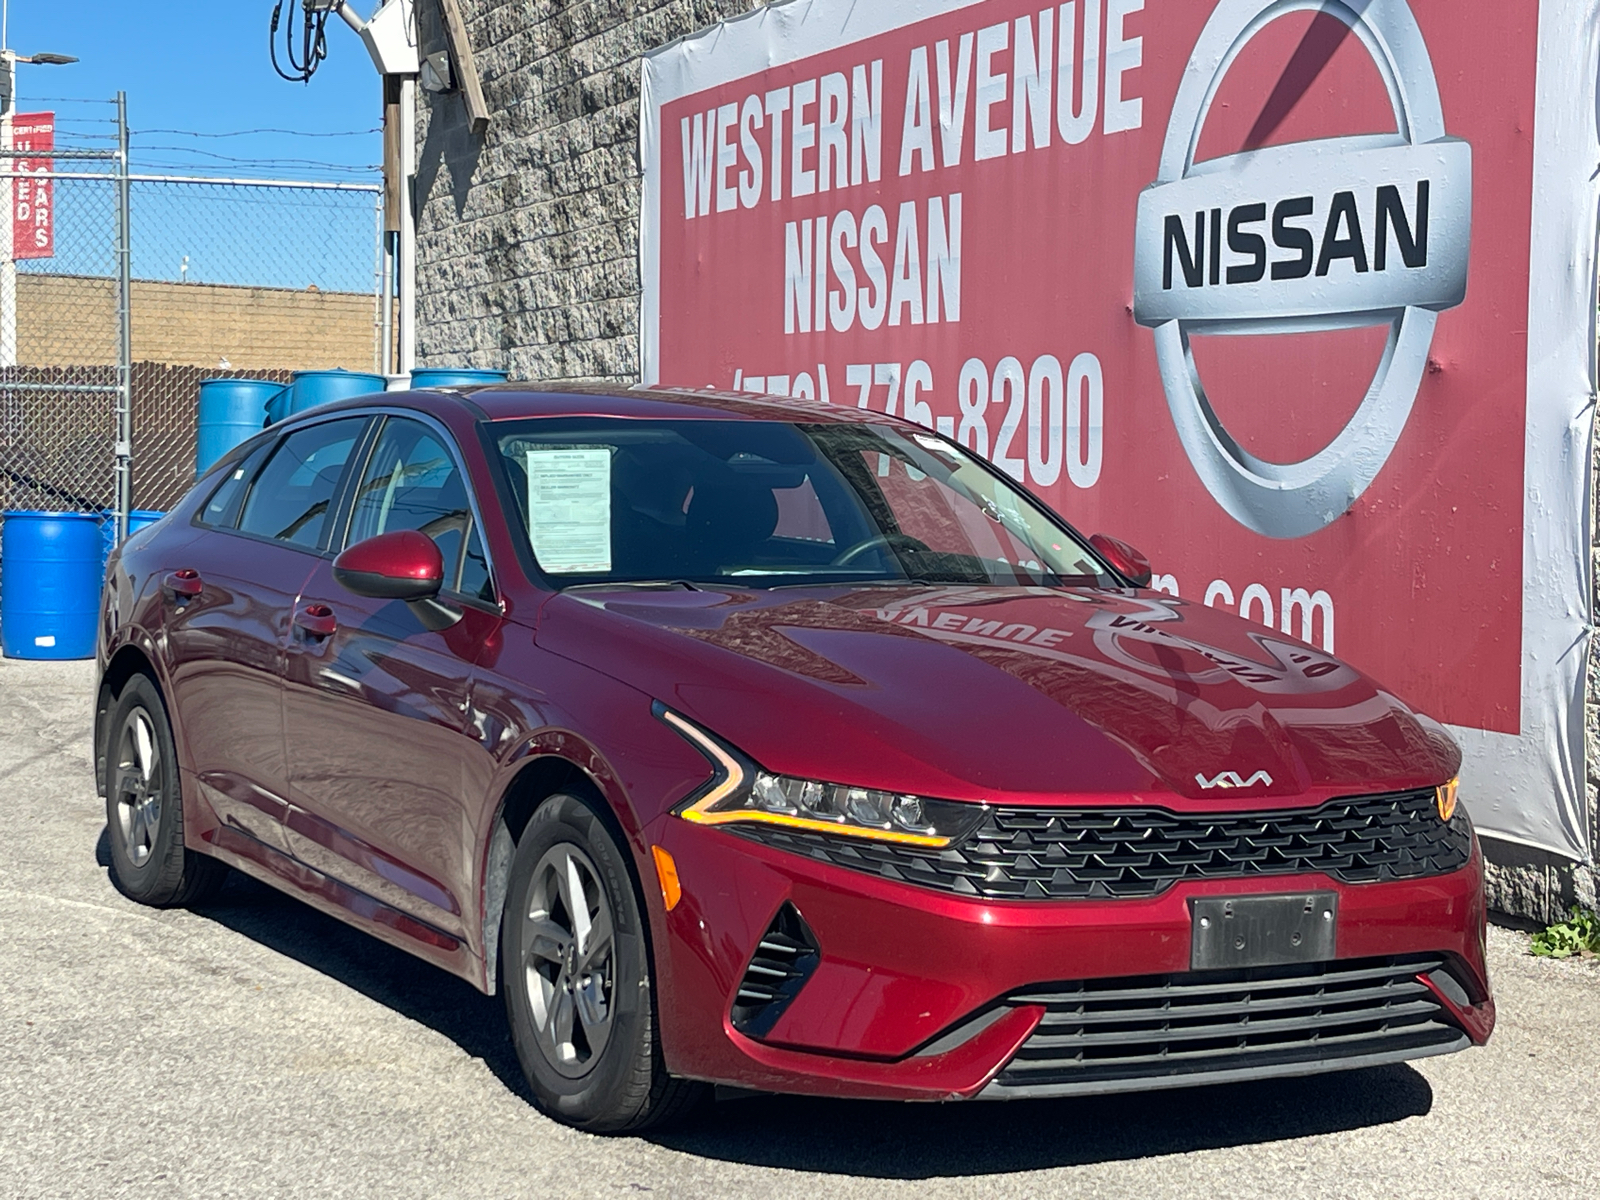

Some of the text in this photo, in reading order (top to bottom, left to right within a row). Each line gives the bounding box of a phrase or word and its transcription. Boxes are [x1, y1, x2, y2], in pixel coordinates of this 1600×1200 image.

[13, 124, 52, 135] CERTIFIED
[680, 0, 1145, 220] WESTERN AVENUE
[35, 166, 48, 248] CARS
[1162, 180, 1430, 290] NISSAN
[784, 192, 962, 334] NISSAN
